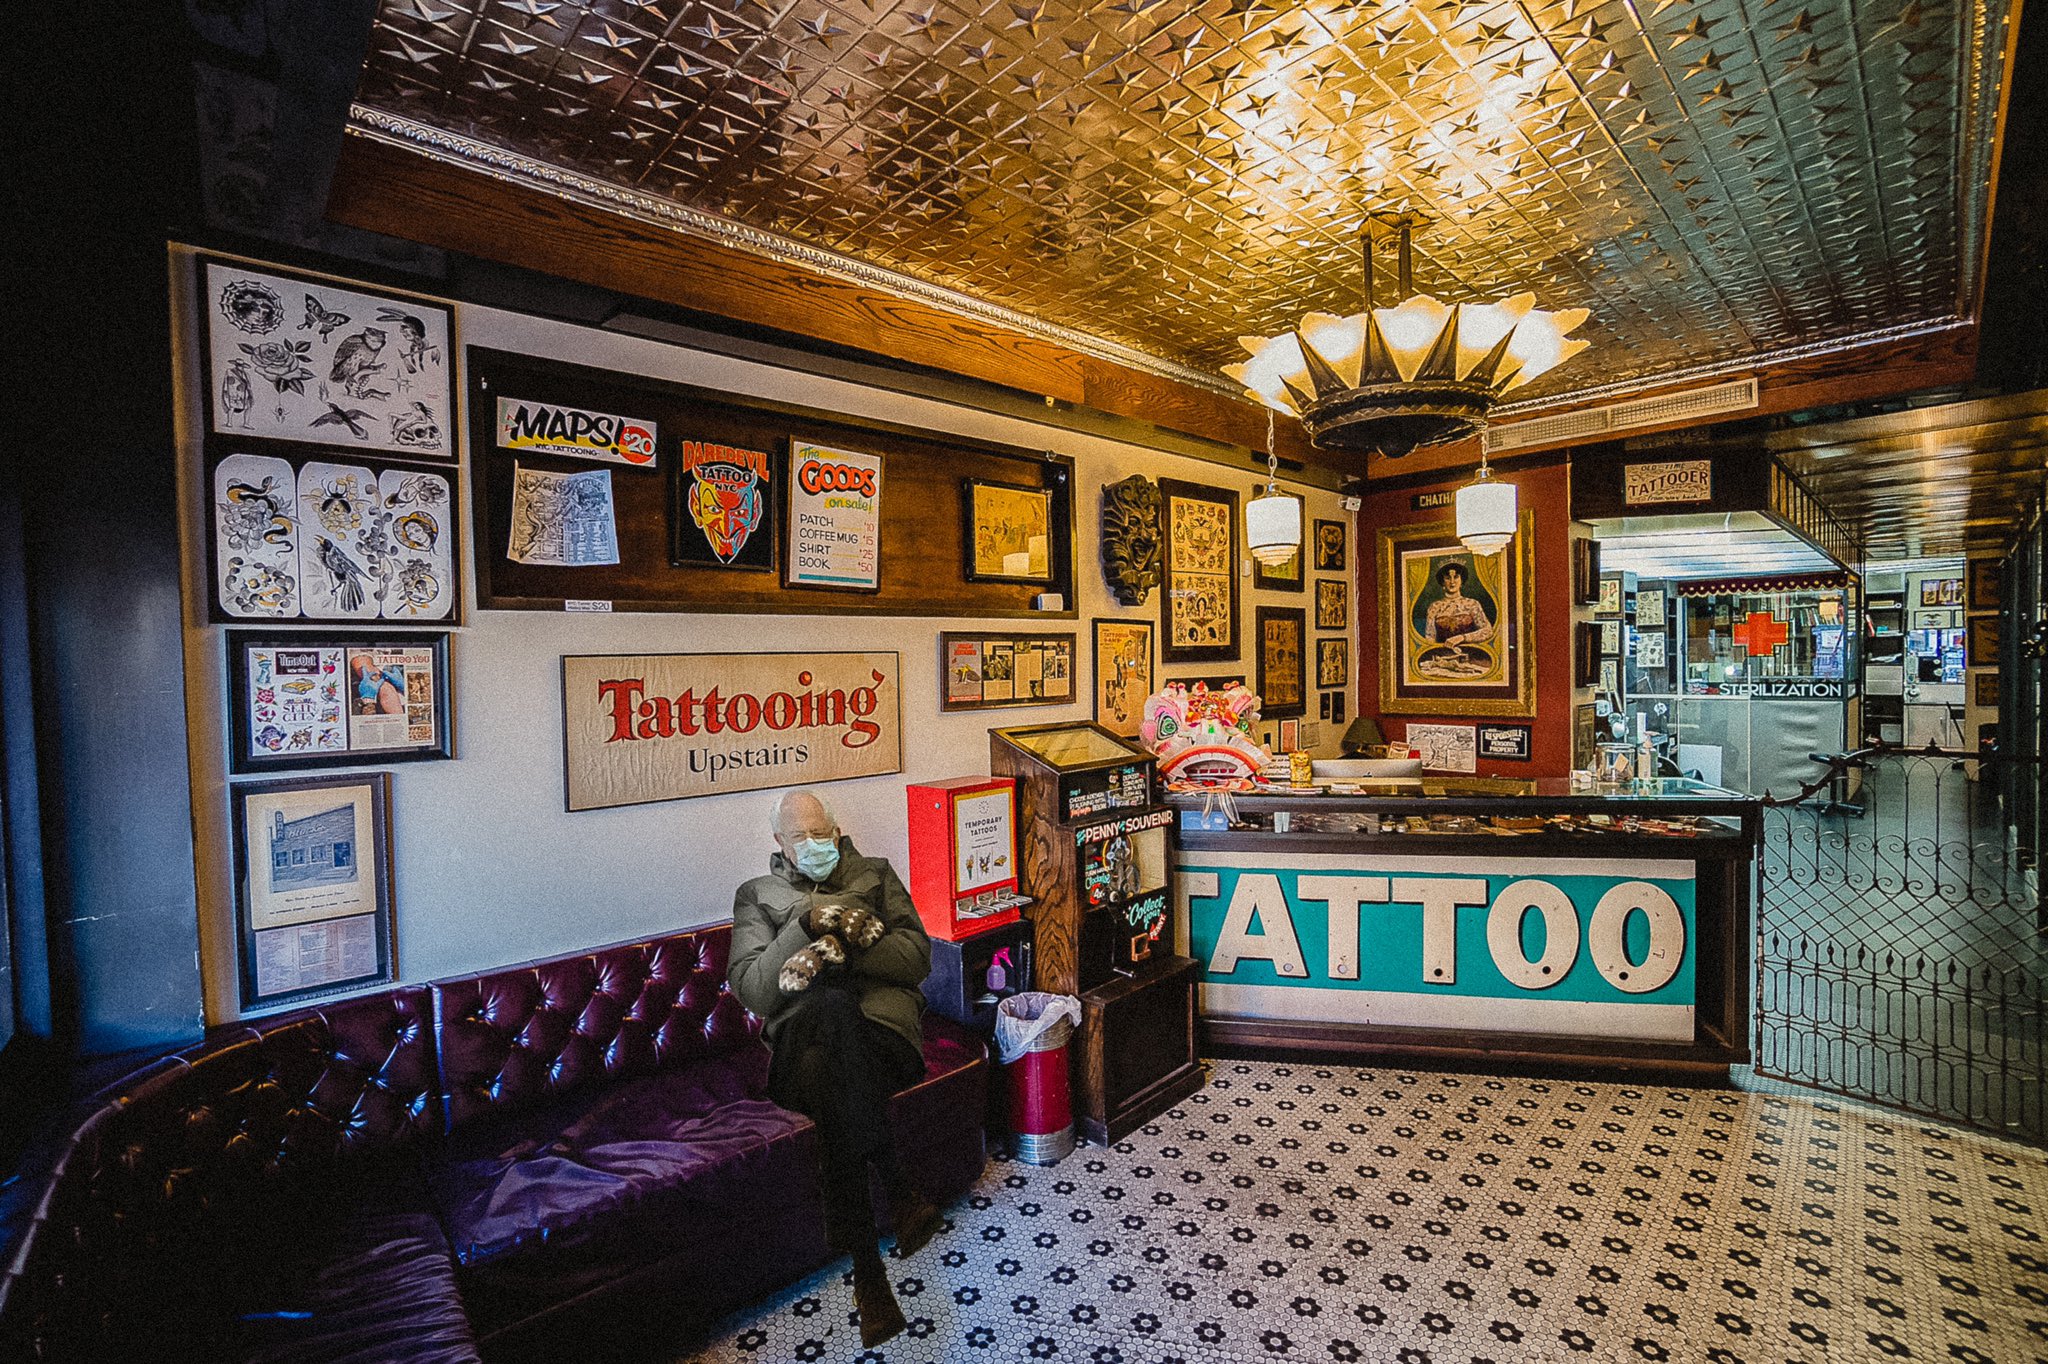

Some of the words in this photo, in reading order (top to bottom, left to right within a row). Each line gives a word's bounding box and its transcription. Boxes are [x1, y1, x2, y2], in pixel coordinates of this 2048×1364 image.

[510, 404, 625, 455] MAPS!
[622, 433, 656, 456] $20
[800, 446, 820, 461] The
[682, 441, 770, 482] DAREDEVIL
[700, 467, 752, 483] TATTOO
[798, 460, 876, 498] GOODS
[715, 483, 737, 492] NYC
[1628, 470, 1709, 497] TATTOOER
[829, 498, 843, 508] on
[800, 513, 834, 527] PATCH
[799, 527, 836, 542] COFFEE
[837, 532, 859, 544] MUG
[799, 542, 832, 555] SHIRT
[798, 556, 831, 570] BOOK
[377, 655, 412, 664] TATTOO
[413, 654, 430, 664] YOU
[1719, 683, 1842, 697] STERILIZATION
[598, 668, 885, 748] Tattooing
[688, 742, 808, 782] Upstairs
[965, 816, 1003, 829] TEMPORARY
[1085, 822, 1120, 843] PENNY
[1126, 810, 1173, 833] SOUVENIR
[970, 825, 997, 837] TATTOOS
[1130, 895, 1165, 926] Collect
